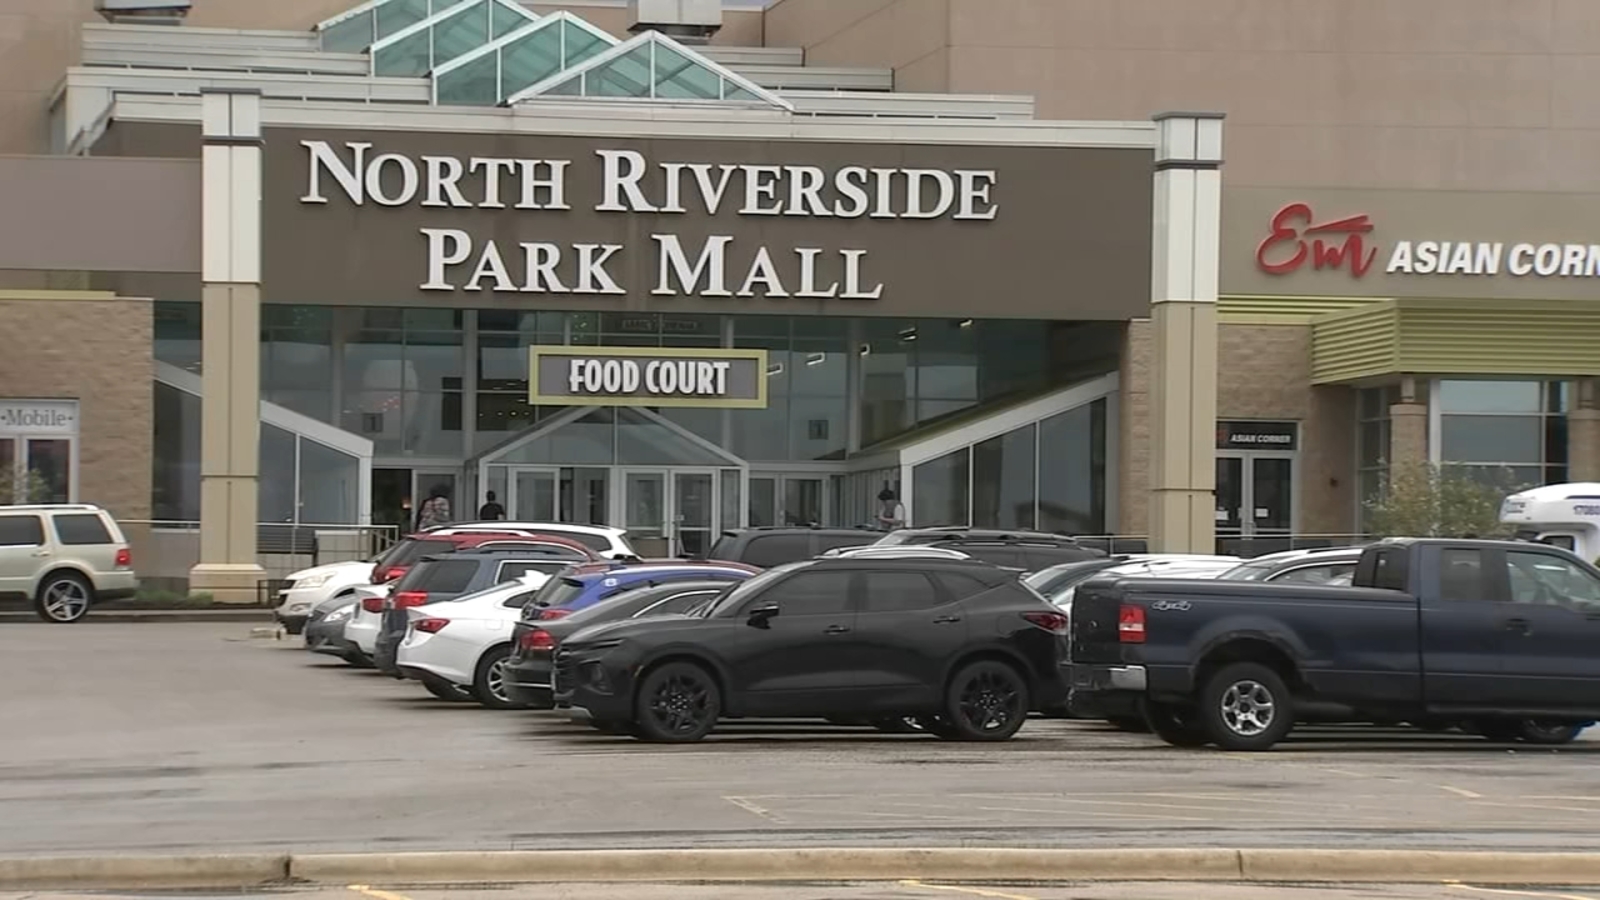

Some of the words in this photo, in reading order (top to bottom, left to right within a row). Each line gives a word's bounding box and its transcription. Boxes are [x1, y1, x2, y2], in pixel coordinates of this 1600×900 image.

[300, 140, 571, 211] NORTH
[595, 149, 998, 221] RIVERSIDE
[419, 227, 626, 295] PARK
[650, 234, 883, 300] MALL
[1386, 240, 1502, 275] ASIAN
[569, 358, 641, 393] FOOD
[645, 360, 731, 395] COURT
[1230, 434, 1256, 442] ASIAN
[1257, 434, 1291, 443] CORNER
